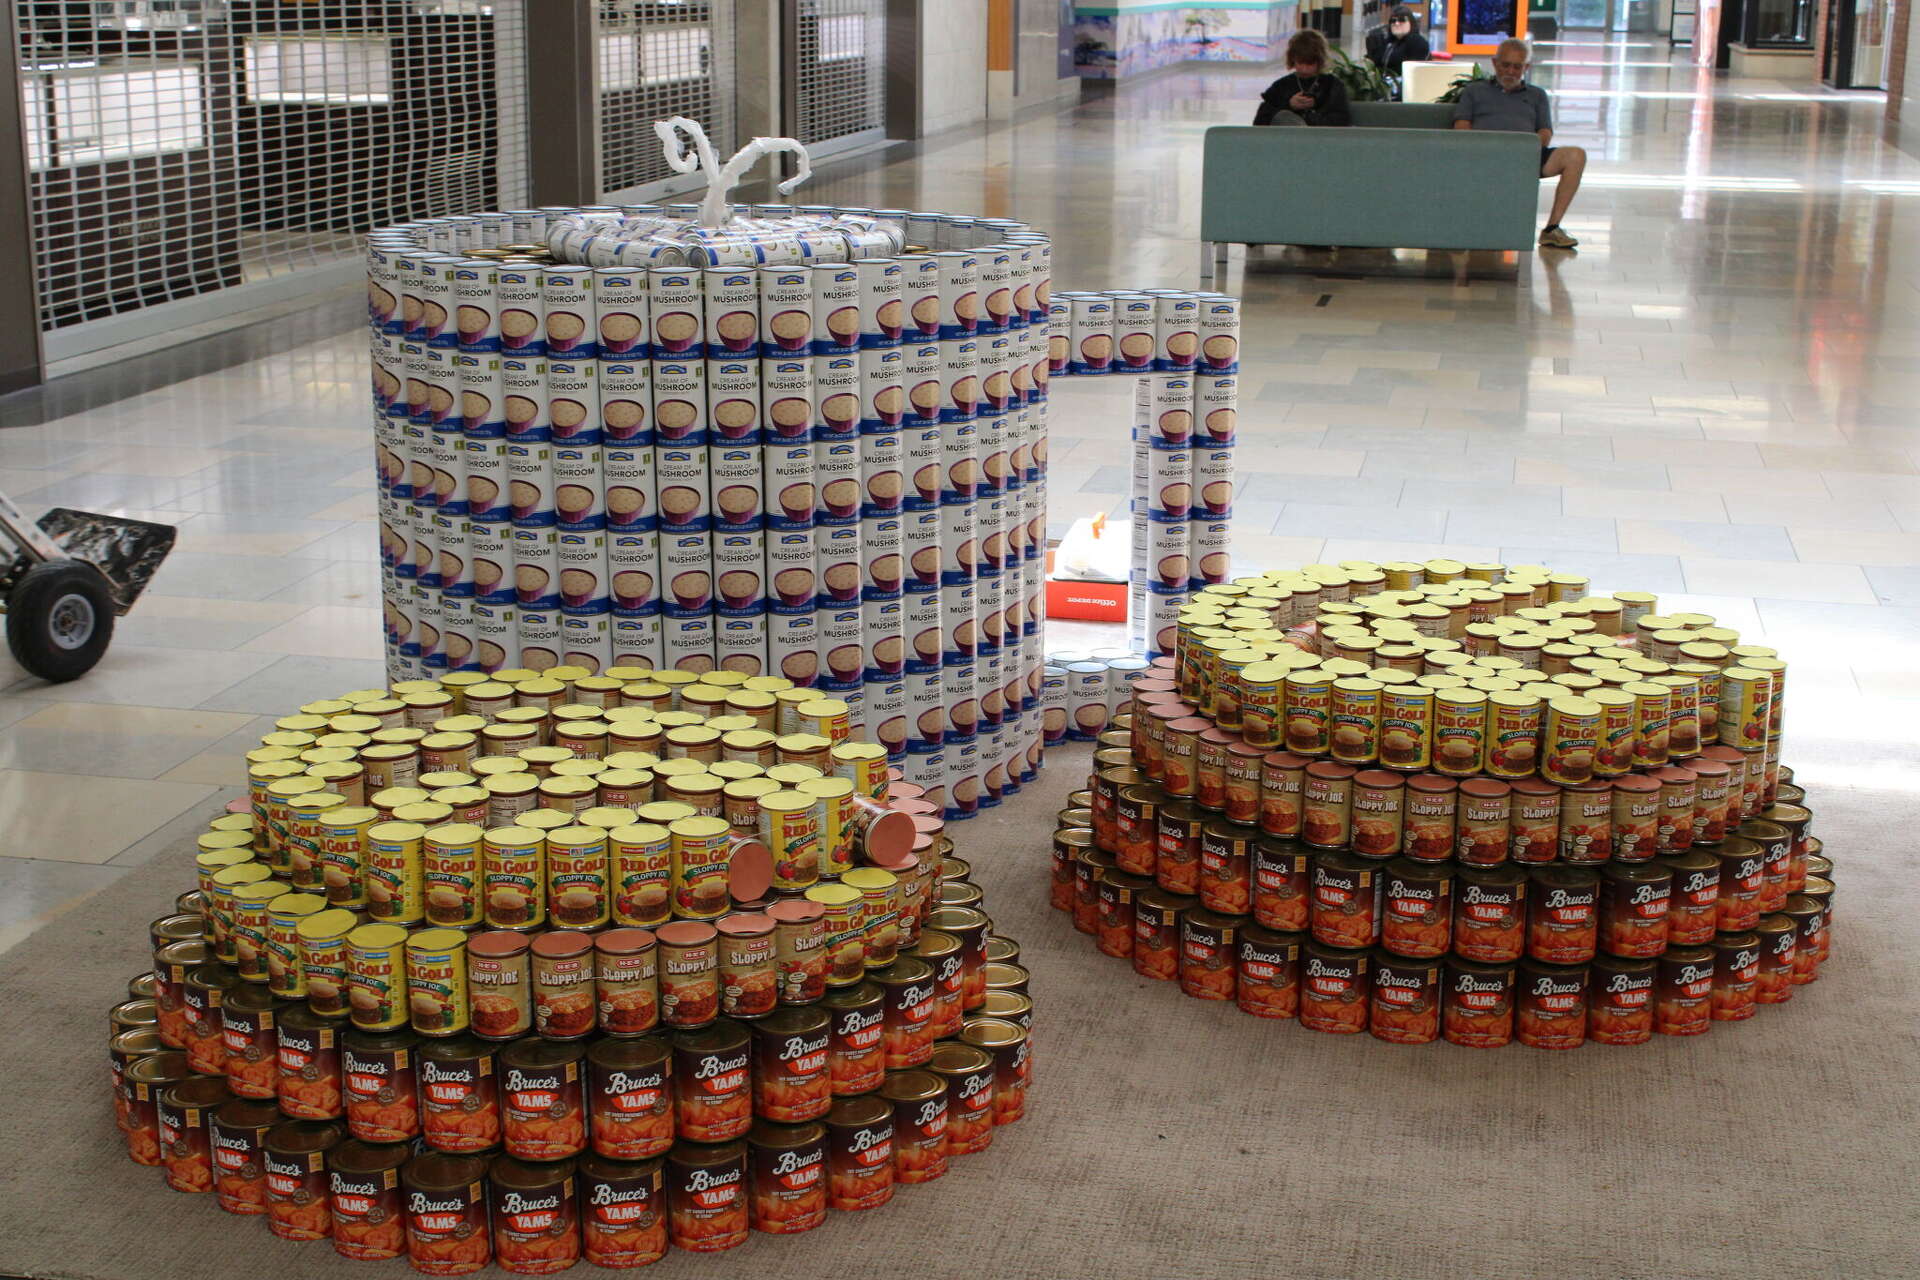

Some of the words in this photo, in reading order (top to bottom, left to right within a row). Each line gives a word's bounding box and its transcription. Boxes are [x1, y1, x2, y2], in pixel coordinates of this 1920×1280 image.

[1249, 695, 1279, 705] GOLD
[1348, 703, 1376, 715] GOLD
[1641, 709, 1662, 720] RED
[1498, 718, 1521, 730] RED
[1606, 716, 1629, 728] RED
[1557, 725, 1579, 737] RED
[1176, 744, 1191, 755] JOE
[1245, 770, 1260, 780] JOE
[1285, 781, 1299, 792] JOE
[1328, 792, 1343, 803] JOE
[1411, 803, 1442, 816] SLOPPY
[1468, 808, 1499, 821] SLOPPY
[1523, 807, 1554, 818] SLOPPY
[783, 823, 807, 836] RED
[326, 839, 360, 852] GOLD
[372, 853, 404, 869] GOLD
[620, 857, 648, 871] RED
[681, 850, 707, 864] RED
[440, 858, 475, 873] GOLD
[503, 859, 538, 874] GOLD
[490, 874, 512, 883] SLOPPY
[514, 875, 526, 884] JOE
[558, 874, 582, 883] SLOPPY
[583, 874, 596, 882] JOE
[1319, 889, 1345, 903] YAMS
[1396, 901, 1426, 914] YAMS
[1474, 906, 1504, 919] YAMS
[1559, 907, 1587, 920] YAMS
[1643, 903, 1667, 916] YAMS
[824, 919, 848, 932] RED
[731, 951, 769, 965] SLOPPY
[358, 960, 393, 977] GOLD
[418, 964, 454, 980] GOLD
[668, 960, 705, 974] SLOPPY
[1247, 963, 1274, 977] YAMS
[501, 970, 517, 984] JOE
[540, 971, 578, 986] SLOPPY
[603, 967, 639, 982] SLOPPY
[1316, 979, 1344, 992] YAMS
[1385, 988, 1413, 1002] YAMS
[1466, 993, 1496, 1007] YAMS
[1620, 991, 1646, 1004] YAMS
[1544, 996, 1574, 1009] YAMS
[853, 1028, 882, 1045] YAMS
[795, 1052, 826, 1071] YAMS
[350, 1078, 379, 1092] YAMS
[711, 1071, 744, 1090] YAMS
[431, 1086, 464, 1100] YAMS
[516, 1093, 552, 1107] YAMS
[620, 1092, 656, 1108] YAMS
[790, 1168, 820, 1185] YAMS
[268, 1177, 294, 1192] YAMS
[700, 1188, 736, 1205] YAMS
[337, 1197, 368, 1212] YAMS
[604, 1206, 640, 1220] YAMS
[421, 1216, 456, 1228] YAMS
[515, 1215, 552, 1228] YAMS
